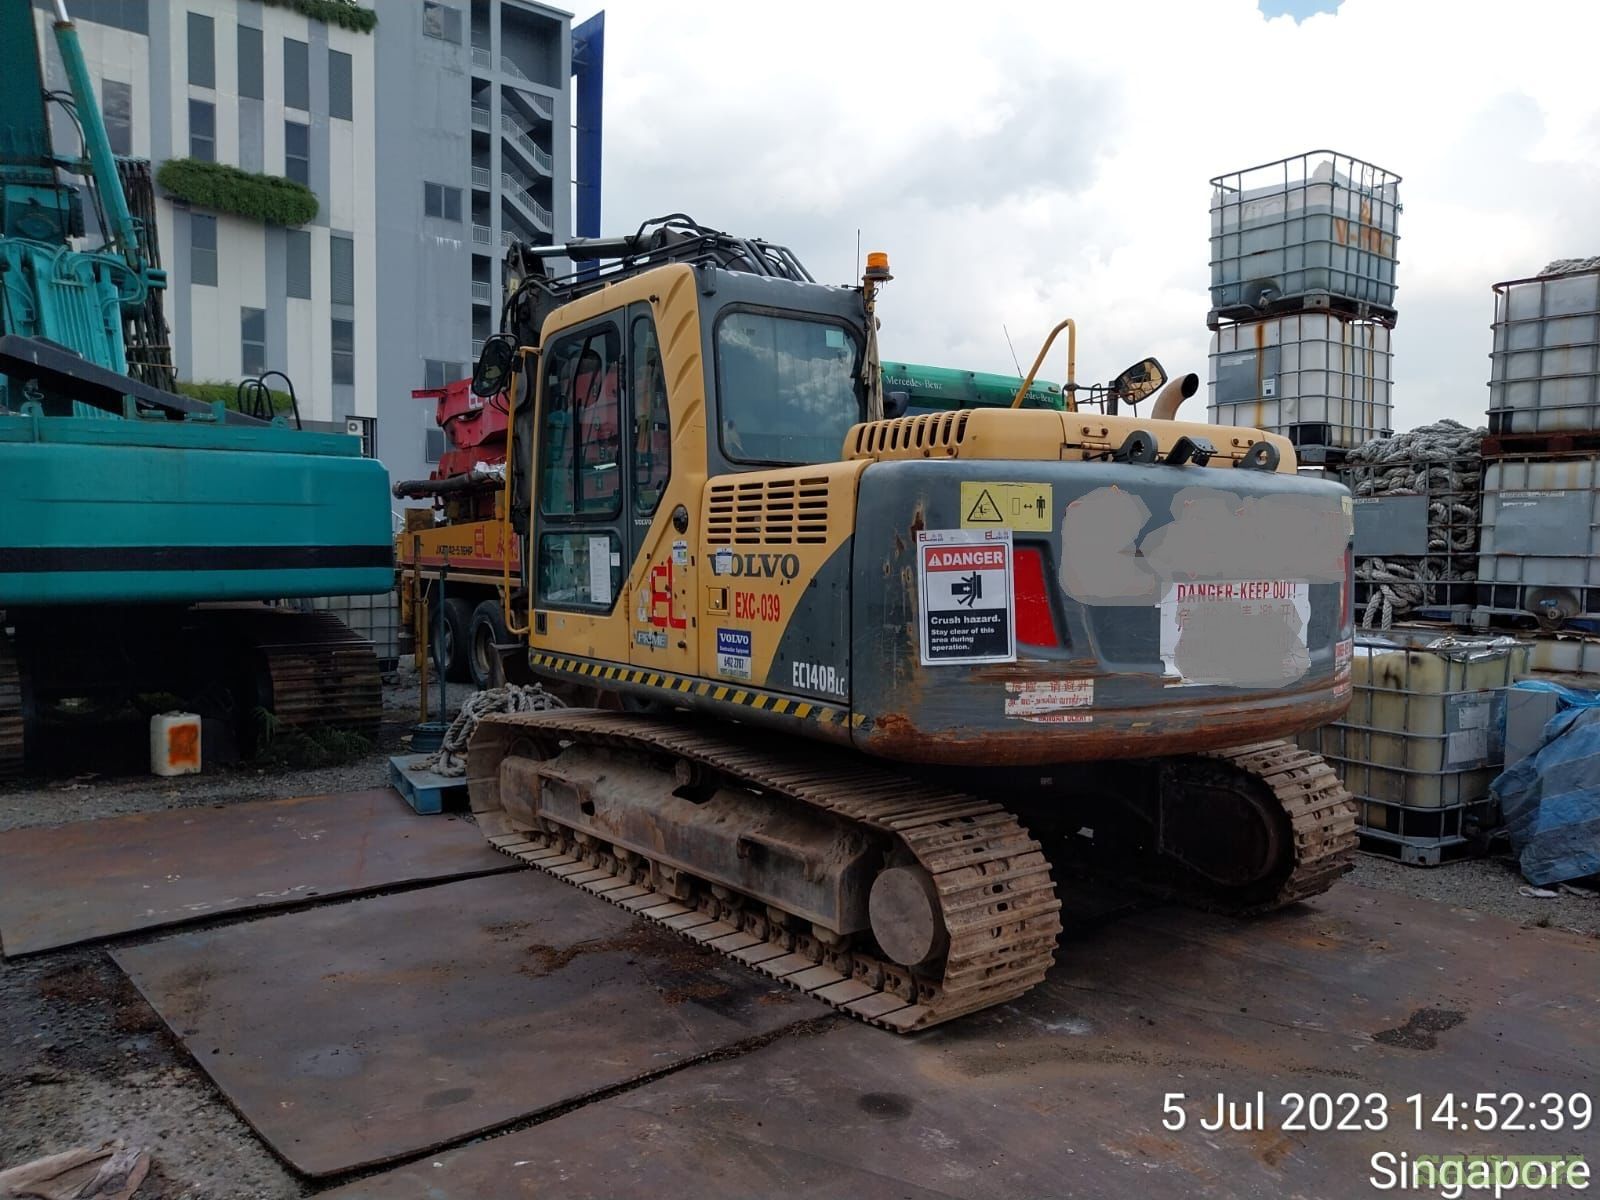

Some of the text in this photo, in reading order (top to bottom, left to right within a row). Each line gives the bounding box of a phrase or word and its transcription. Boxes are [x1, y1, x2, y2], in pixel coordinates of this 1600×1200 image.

[885, 376, 943, 390] Mercedes-Benz
[942, 551, 1004, 566] DANGER
[735, 591, 781, 622] EXC-039
[930, 614, 1001, 625] Crush hazard.
[931, 628, 948, 636] Stay
[949, 627, 969, 635] clear
[980, 626, 995, 634] this
[720, 632, 749, 645] VOLVO
[950, 635, 974, 644] during
[931, 643, 970, 652] operation.
